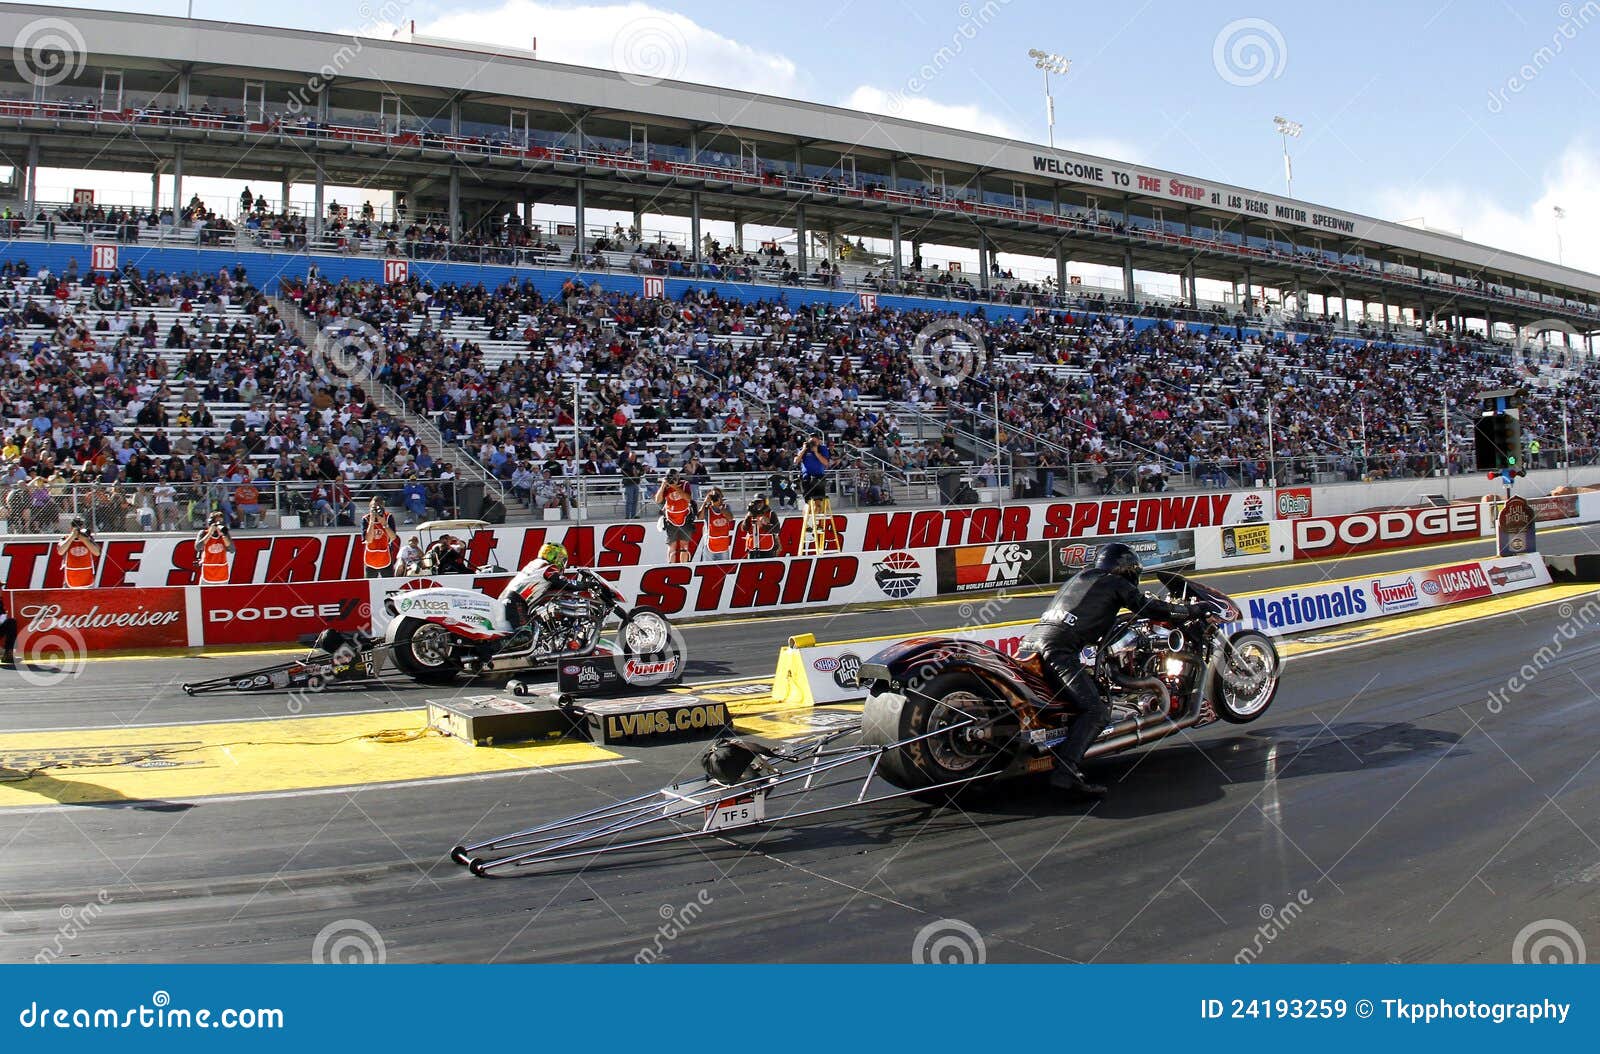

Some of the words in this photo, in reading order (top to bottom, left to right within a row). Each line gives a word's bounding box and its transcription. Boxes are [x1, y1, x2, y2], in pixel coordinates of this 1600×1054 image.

[1033, 156, 1103, 181] WELCOME
[1112, 171, 1130, 187] TO
[1137, 174, 1161, 192] THE
[1169, 178, 1205, 199] STRIP
[1211, 193, 1221, 205] at
[1227, 197, 1242, 210] LAS
[1245, 200, 1269, 215] VEGAS
[1275, 206, 1306, 223] MOTOR
[1312, 213, 1355, 233] SPEEDWAY
[95, 247, 115, 269] 1B
[386, 262, 406, 284] 1C
[863, 506, 1030, 550] MOTOR
[1042, 494, 1232, 540] SPEEDWAY
[1297, 505, 1478, 550] DODGE
[1238, 529, 1267, 541] ENERGY
[1239, 536, 1267, 549] DRINK
[635, 555, 859, 614] STRIP
[1438, 570, 1470, 594] LUCAS
[1470, 568, 1487, 588] OIL
[209, 603, 341, 622] DODGE
[411, 599, 449, 610] Akea
[1249, 585, 1367, 631] Nationals
[20, 604, 179, 632] Budweiser
[816, 659, 837, 670] NHRA
[608, 705, 724, 738] LVMS.COM
[722, 811, 737, 822] TF
[741, 809, 748, 819] 5
